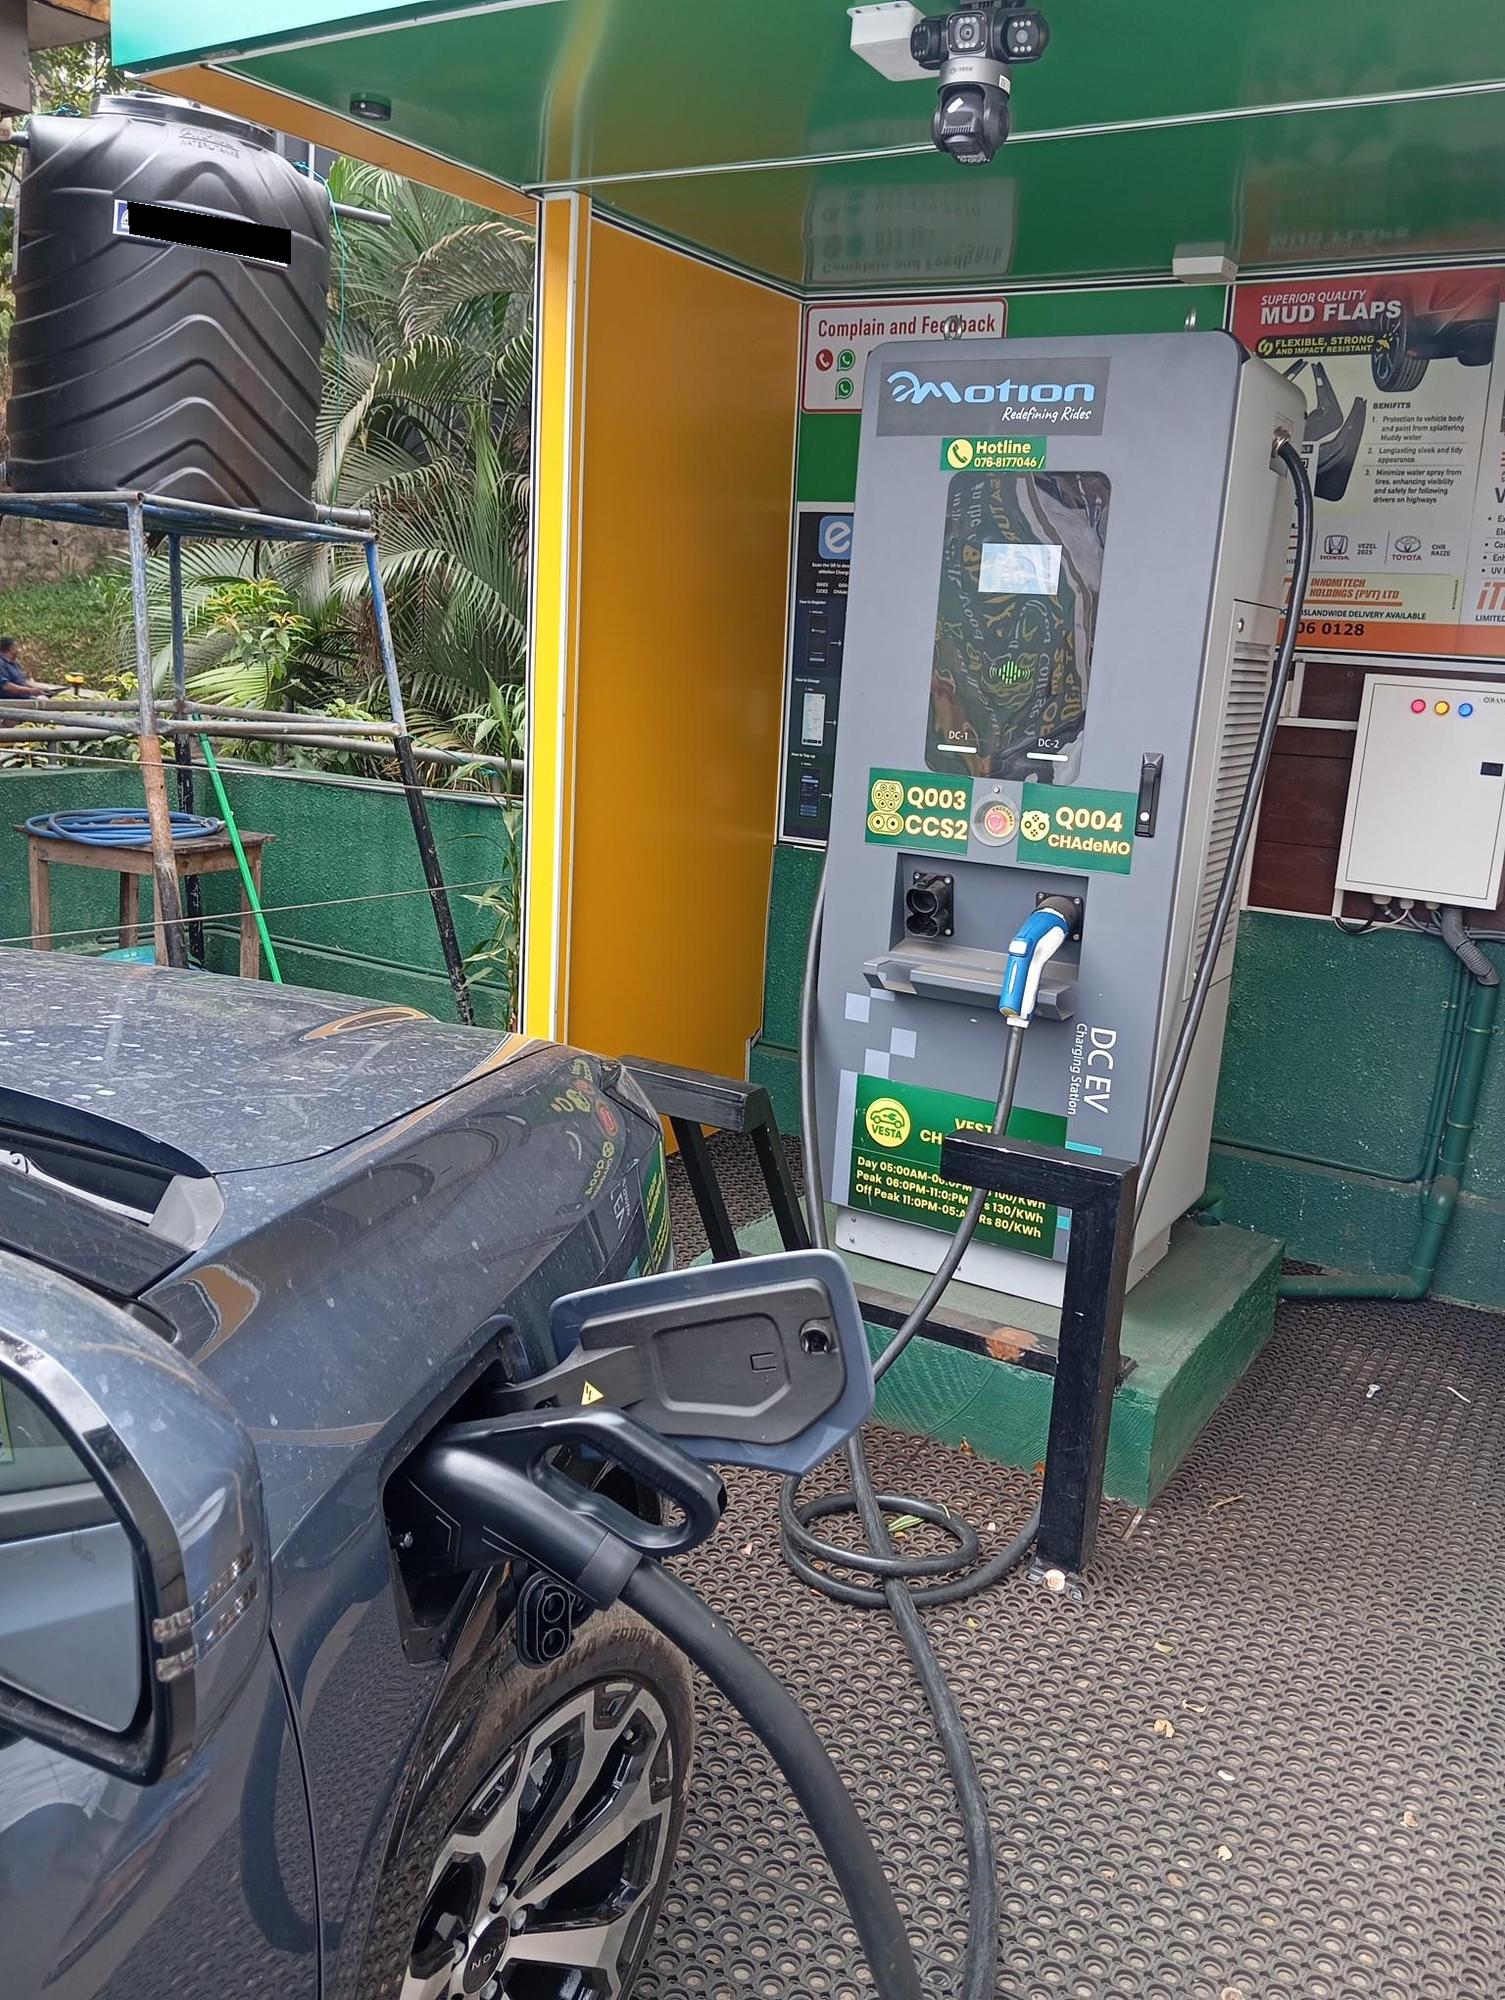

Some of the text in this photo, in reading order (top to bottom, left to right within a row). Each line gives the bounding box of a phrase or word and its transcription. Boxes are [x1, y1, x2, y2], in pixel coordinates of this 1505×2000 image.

[1261, 289, 1367, 306] SUPERIOR QUALITY
[1260, 300, 1402, 325] MUD FLAPS
[818, 317, 885, 341] Complain
[890, 316, 917, 335] and
[1275, 335, 1375, 349] FLEXIBLE, STRONG
[1275, 344, 1373, 355] AND IMPACT RESISTANT
[1373, 401, 1412, 410] BENIFITS
[1001, 406, 1092, 423] Redefining Rides
[1382, 415, 1415, 423] Protection
[1448, 414, 1465, 423] body
[1394, 425, 1412, 434] paint
[1429, 424, 1465, 433] splattering
[976, 440, 1032, 454] Hotline
[1379, 447, 1417, 456] Longlasting
[1436, 446, 1450, 454] and
[1376, 468, 1405, 477] Minimize
[1426, 469, 1445, 478] spray
[1445, 468, 1462, 476] from
[1392, 478, 1427, 487] enhancing
[1427, 478, 1455, 487] visibility
[1373, 487, 1387, 495] and
[1387, 487, 1407, 496] safety
[1418, 486, 1449, 496] following
[1373, 496, 1396, 504] drivers
[1406, 496, 1438, 505] highways
[1309, 588, 1353, 598] HOLDINGS
[1382, 590, 1400, 599] LTD
[1348, 610, 1384, 619] DELIVERY
[1385, 611, 1427, 621] AVAILABLE
[1321, 621, 1365, 636] 0128
[948, 730, 969, 741] DC-1
[1038, 738, 1059, 749] DC-2
[907, 786, 967, 811] Q003
[1055, 806, 1123, 833] Q004
[904, 814, 968, 840] CCS2
[1047, 833, 1131, 856] CHAdeMO
[1067, 1023, 1088, 1115] Charging Station
[1083, 1027, 1117, 1114] DC EV
[871, 1124, 903, 1141] VESTA
[857, 1156, 878, 1171] Day
[856, 1169, 882, 1185] Peak
[992, 1202, 1044, 1224] 130/KWh
[855, 1183, 873, 1196] Off
[874, 1188, 900, 1203] Peak
[978, 1214, 993, 1226] Rs
[994, 1217, 1041, 1239] 80/KWh
